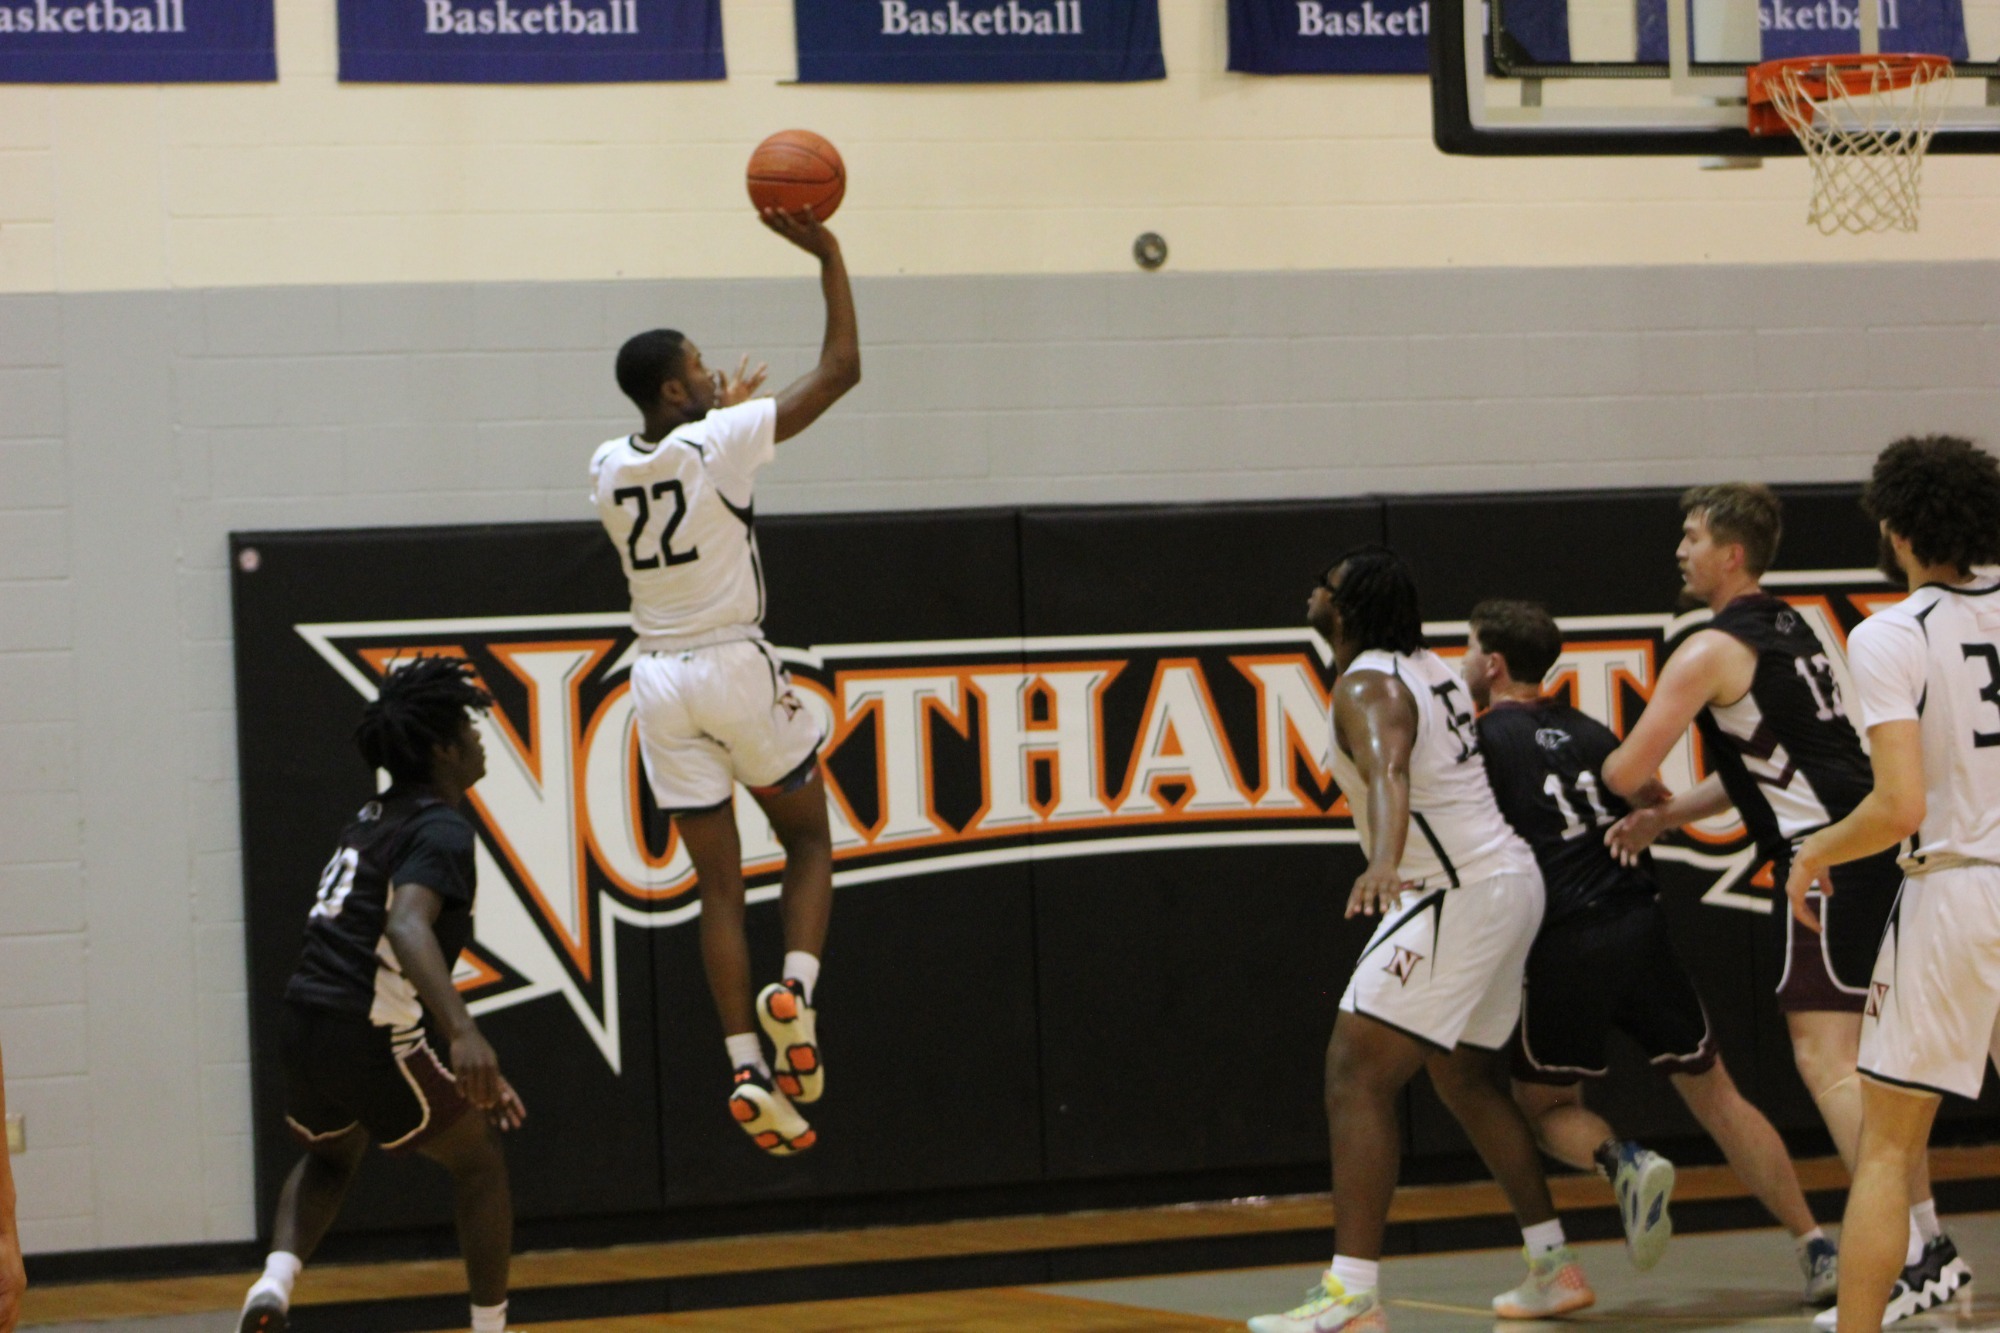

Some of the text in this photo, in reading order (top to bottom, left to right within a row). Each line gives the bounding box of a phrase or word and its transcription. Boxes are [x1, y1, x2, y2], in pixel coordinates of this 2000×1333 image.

[0, 0, 186, 32] asketball
[425, 0, 639, 34] Basketball
[881, 0, 1083, 35] Basketball
[614, 480, 699, 570] 22
[1543, 770, 1616, 841] 11
[1381, 944, 1424, 988] N
